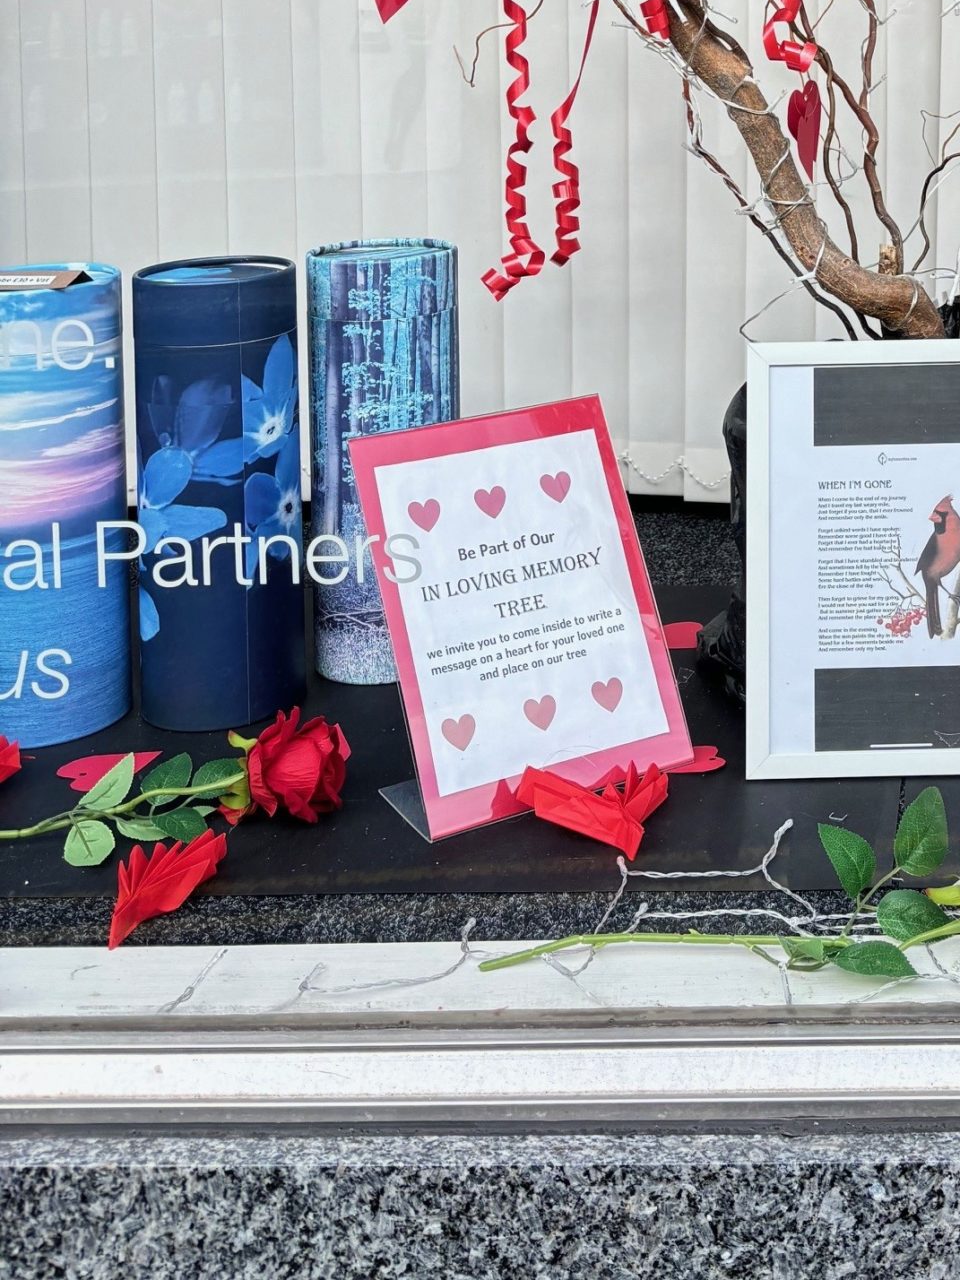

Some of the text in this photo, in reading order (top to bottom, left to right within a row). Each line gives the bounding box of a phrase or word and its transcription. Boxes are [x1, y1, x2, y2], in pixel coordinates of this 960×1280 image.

[818, 480, 892, 489] WHEN I'M GONE
[2, 520, 422, 591] al Partners
[458, 531, 555, 561] Be Part of Our
[421, 547, 602, 602] IN LOVING MEMORY
[494, 594, 548, 619] TREE
[427, 607, 621, 660] we invite you to come inside to write a
[431, 623, 625, 676] message on a heart for your loved one
[480, 647, 587, 682] and place on our tree
